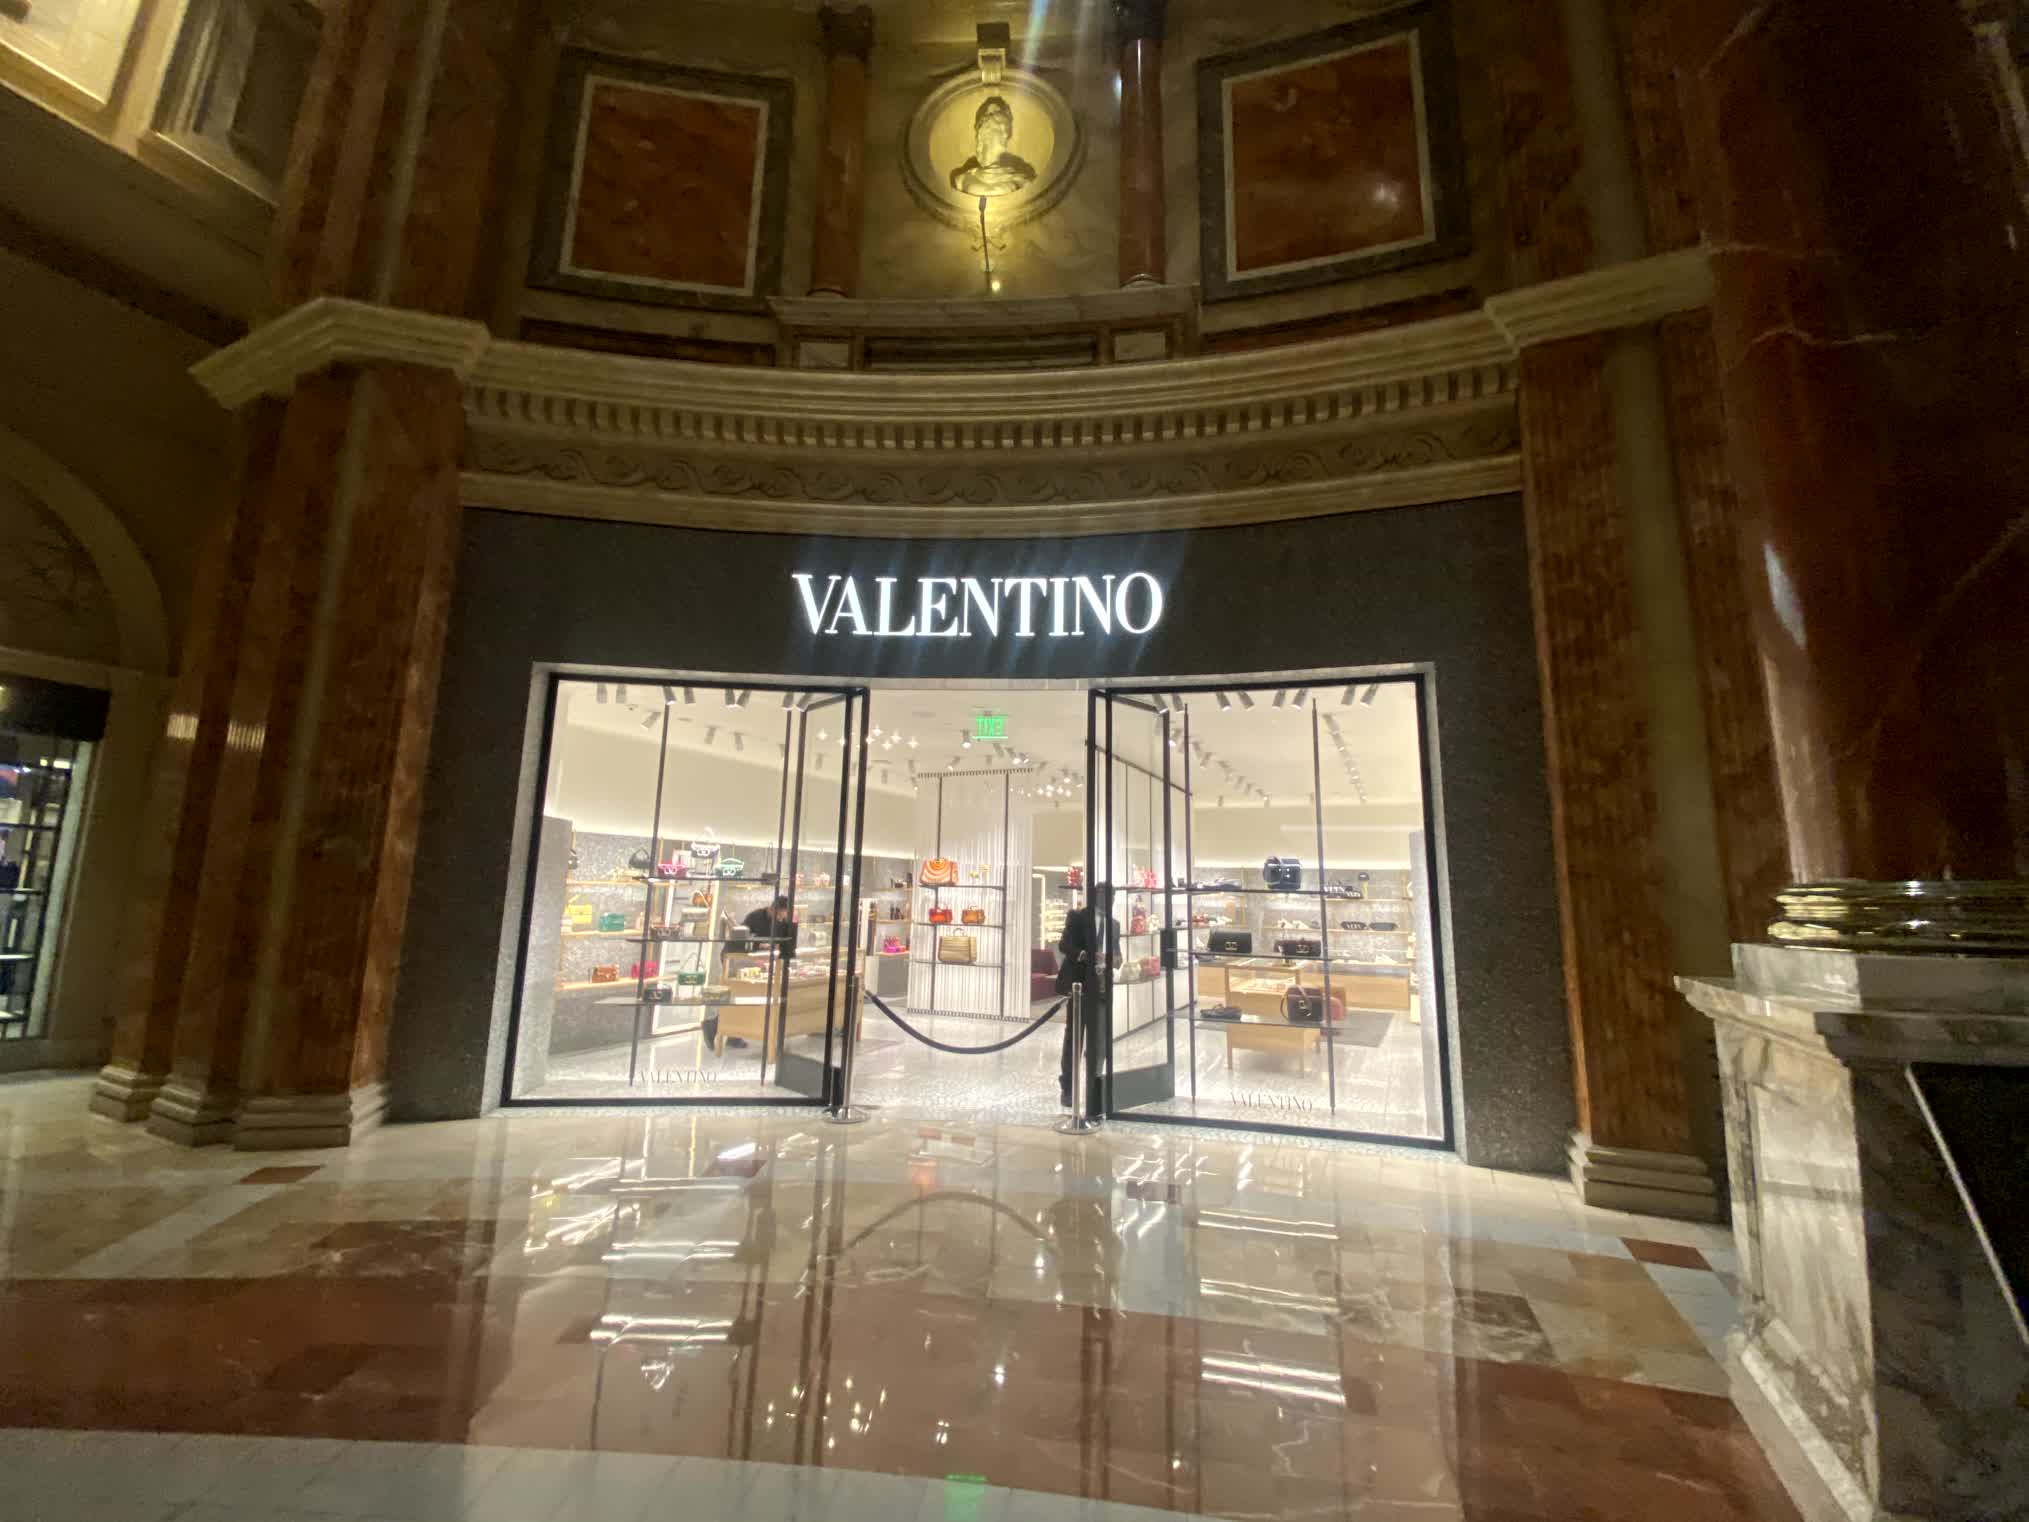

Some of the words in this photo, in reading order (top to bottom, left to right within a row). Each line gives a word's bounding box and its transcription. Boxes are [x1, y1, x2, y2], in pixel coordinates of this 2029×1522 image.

[791, 571, 1164, 637] VALENTINO
[640, 1070, 717, 1084] VALENTINO
[1230, 1091, 1313, 1112] VALENTINO
